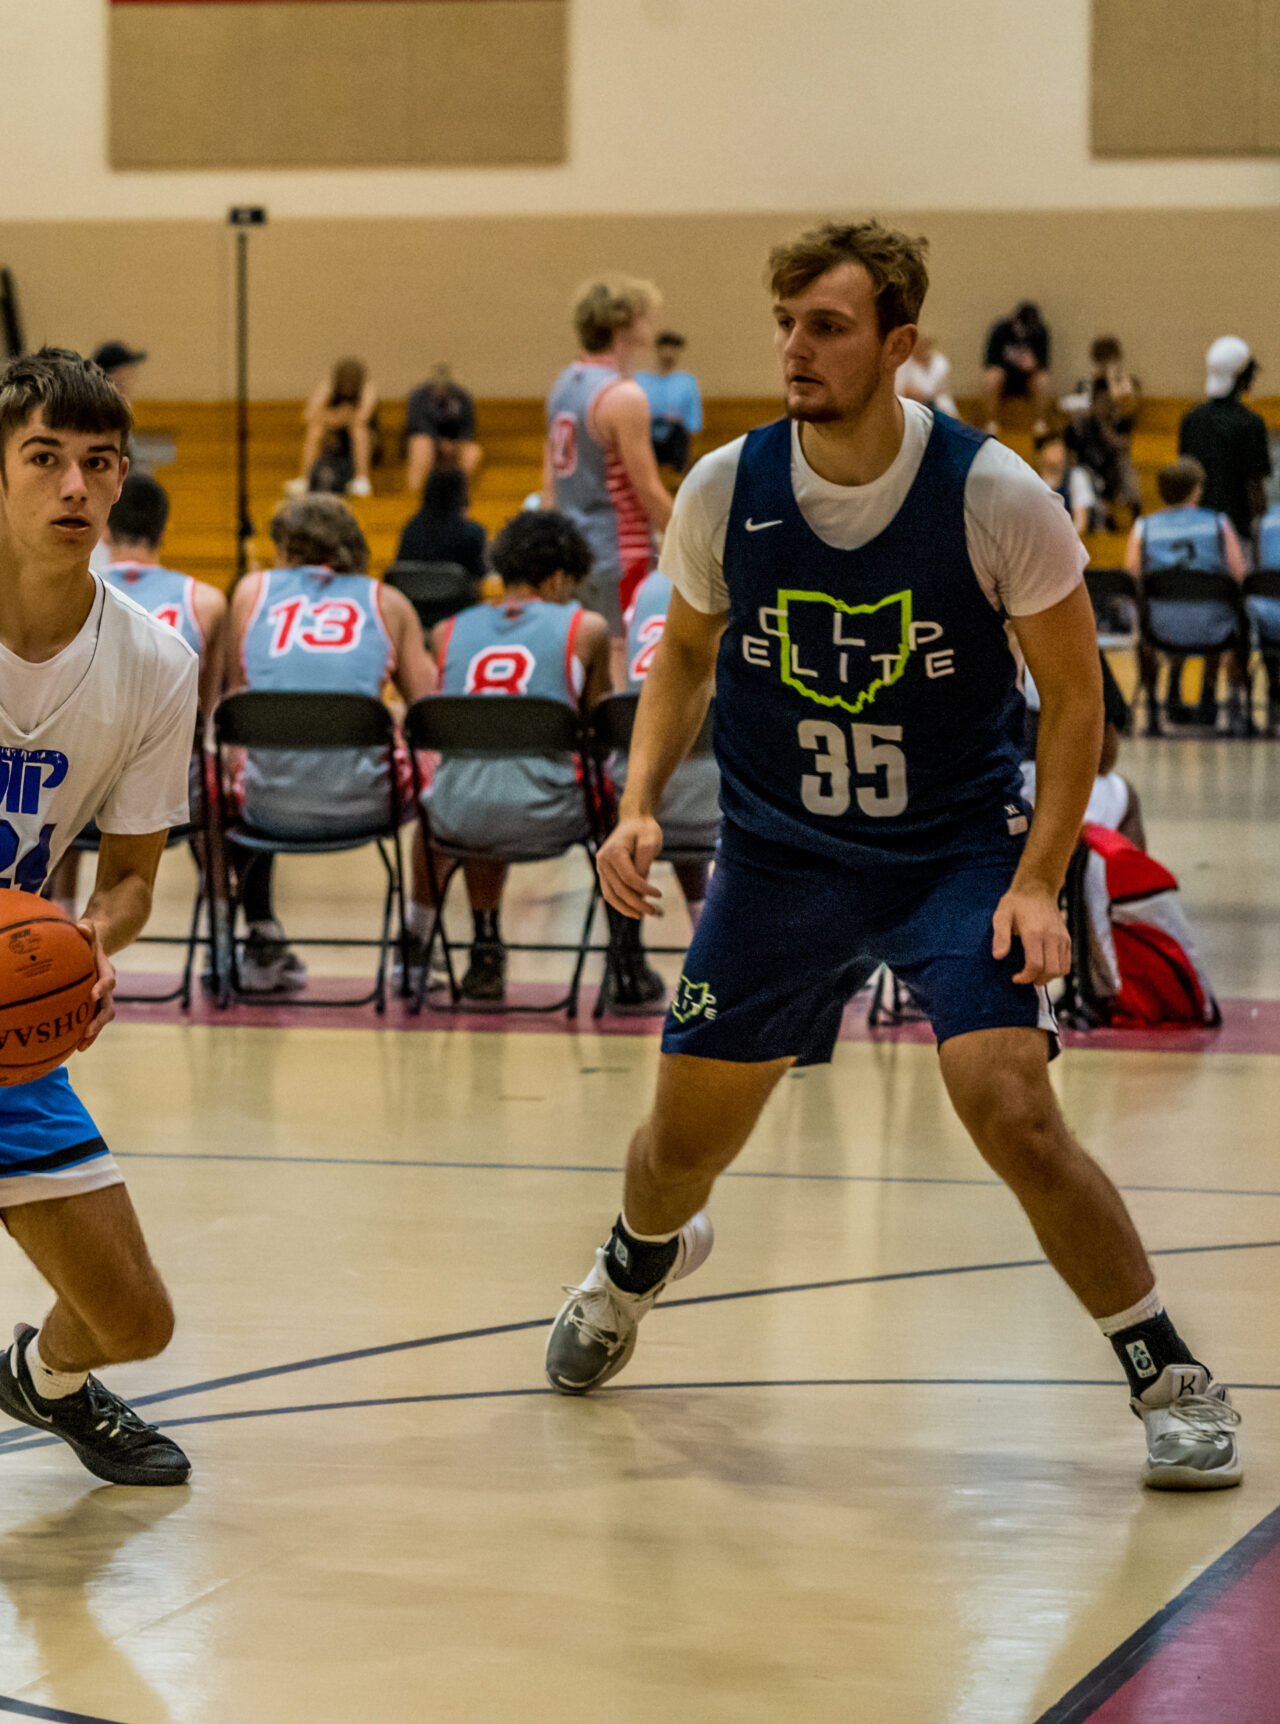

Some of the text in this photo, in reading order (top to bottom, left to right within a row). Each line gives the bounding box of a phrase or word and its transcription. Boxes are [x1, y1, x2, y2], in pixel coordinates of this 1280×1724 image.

[268, 596, 366, 657] 13
[465, 645, 535, 694] 8
[742, 634, 956, 684] ELITE
[796, 718, 908, 818] 35
